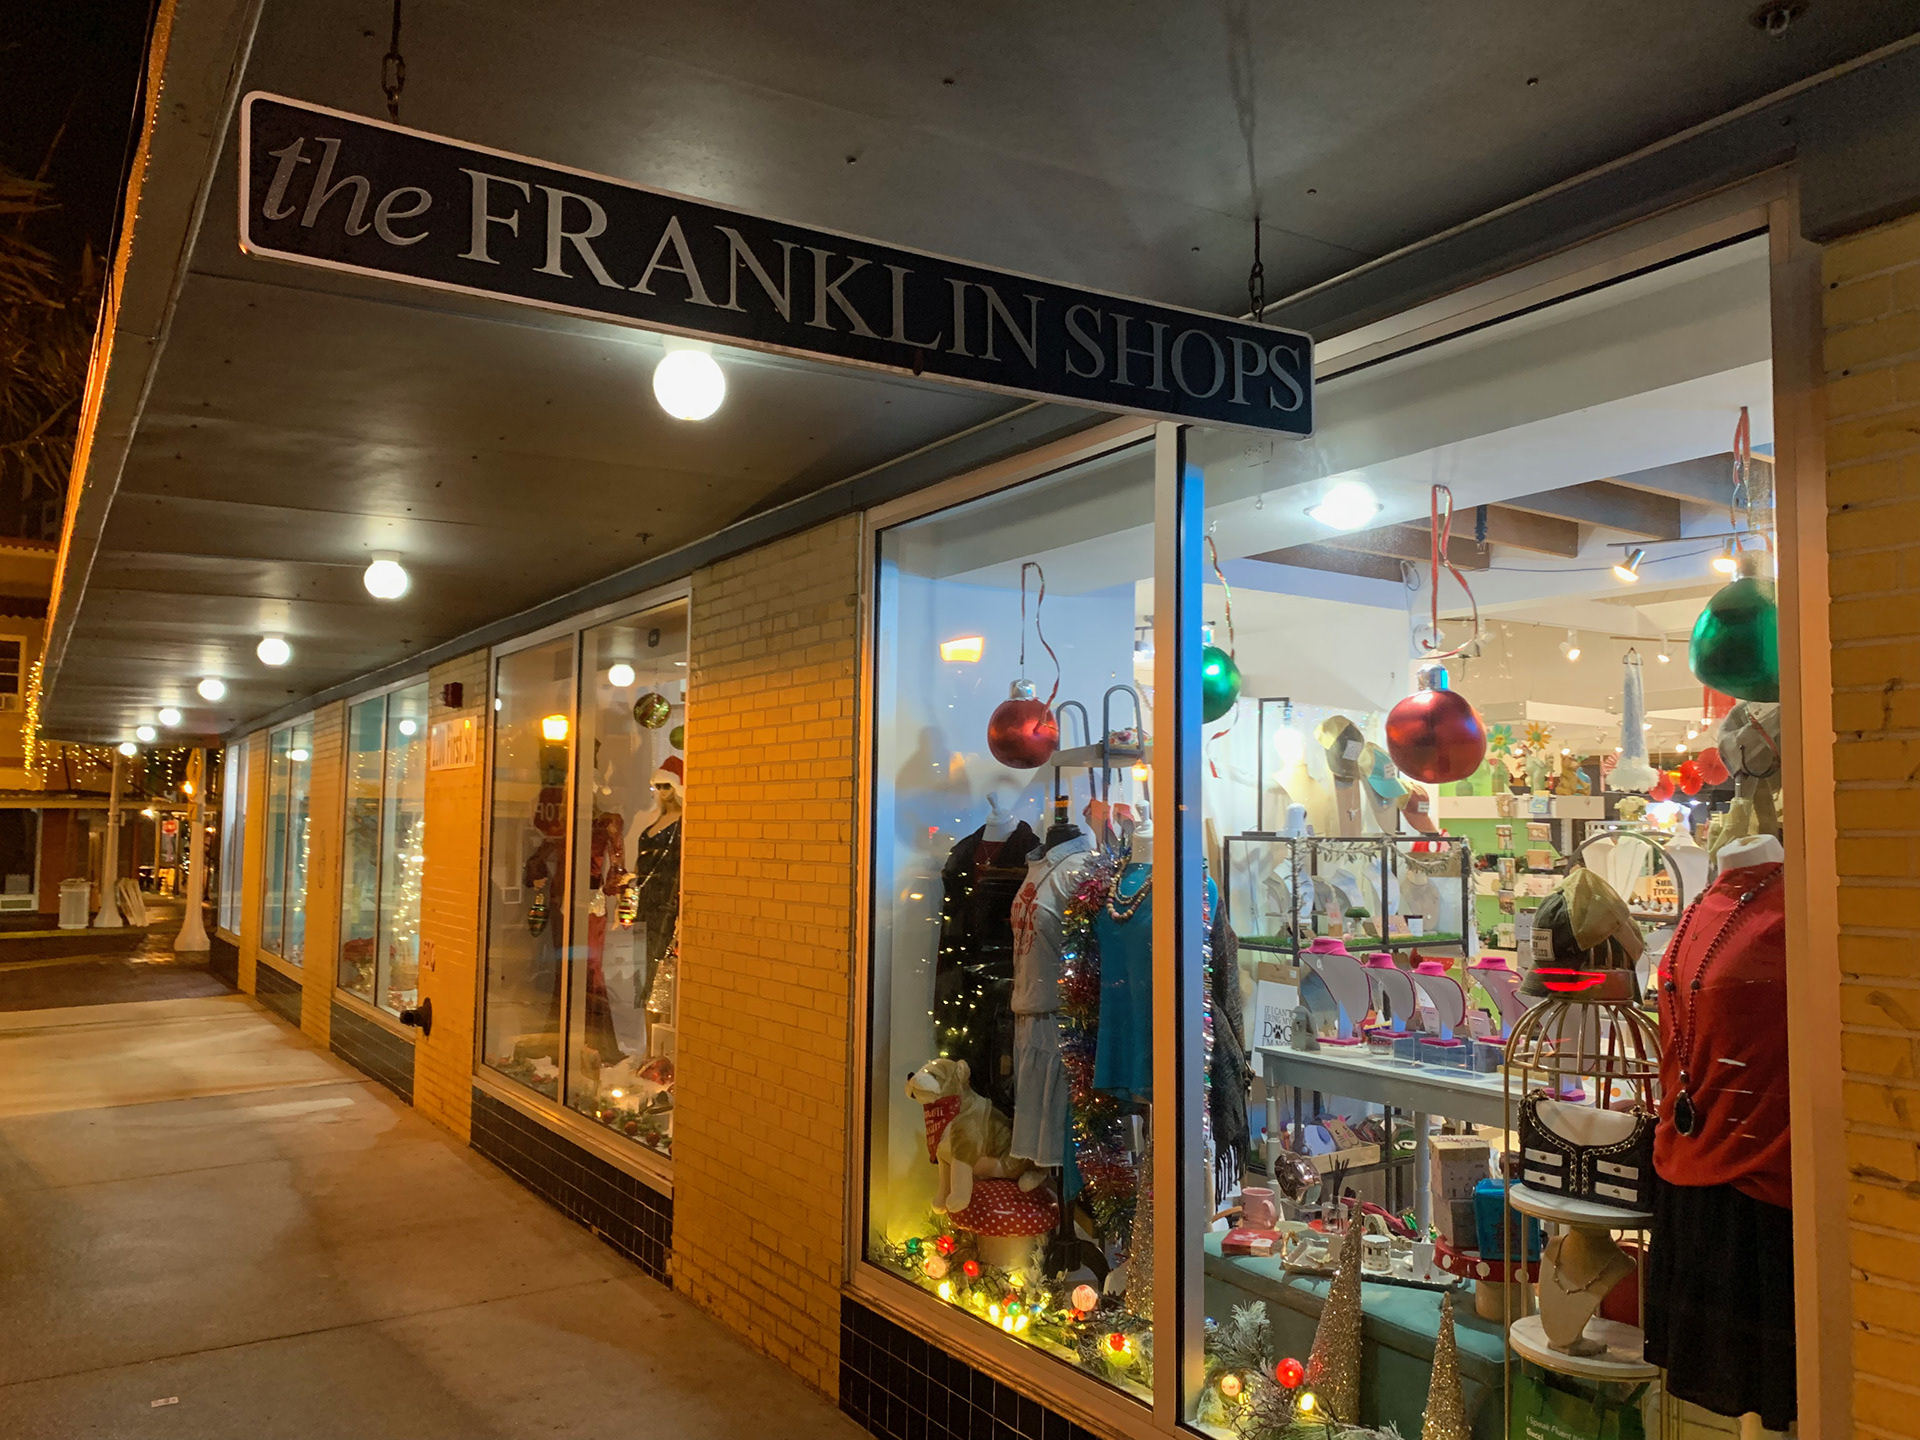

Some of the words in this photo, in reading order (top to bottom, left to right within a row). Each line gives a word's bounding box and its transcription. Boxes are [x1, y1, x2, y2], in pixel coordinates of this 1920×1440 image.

[262, 137, 433, 246] the
[458, 167, 1046, 370] FRANKLIN
[1064, 304, 1303, 412] SHOPS
[1526, 1428, 1544, 1440] Gucci
[1530, 1417, 1550, 1431] Speak
[1551, 1426, 1571, 1440] Fluent
